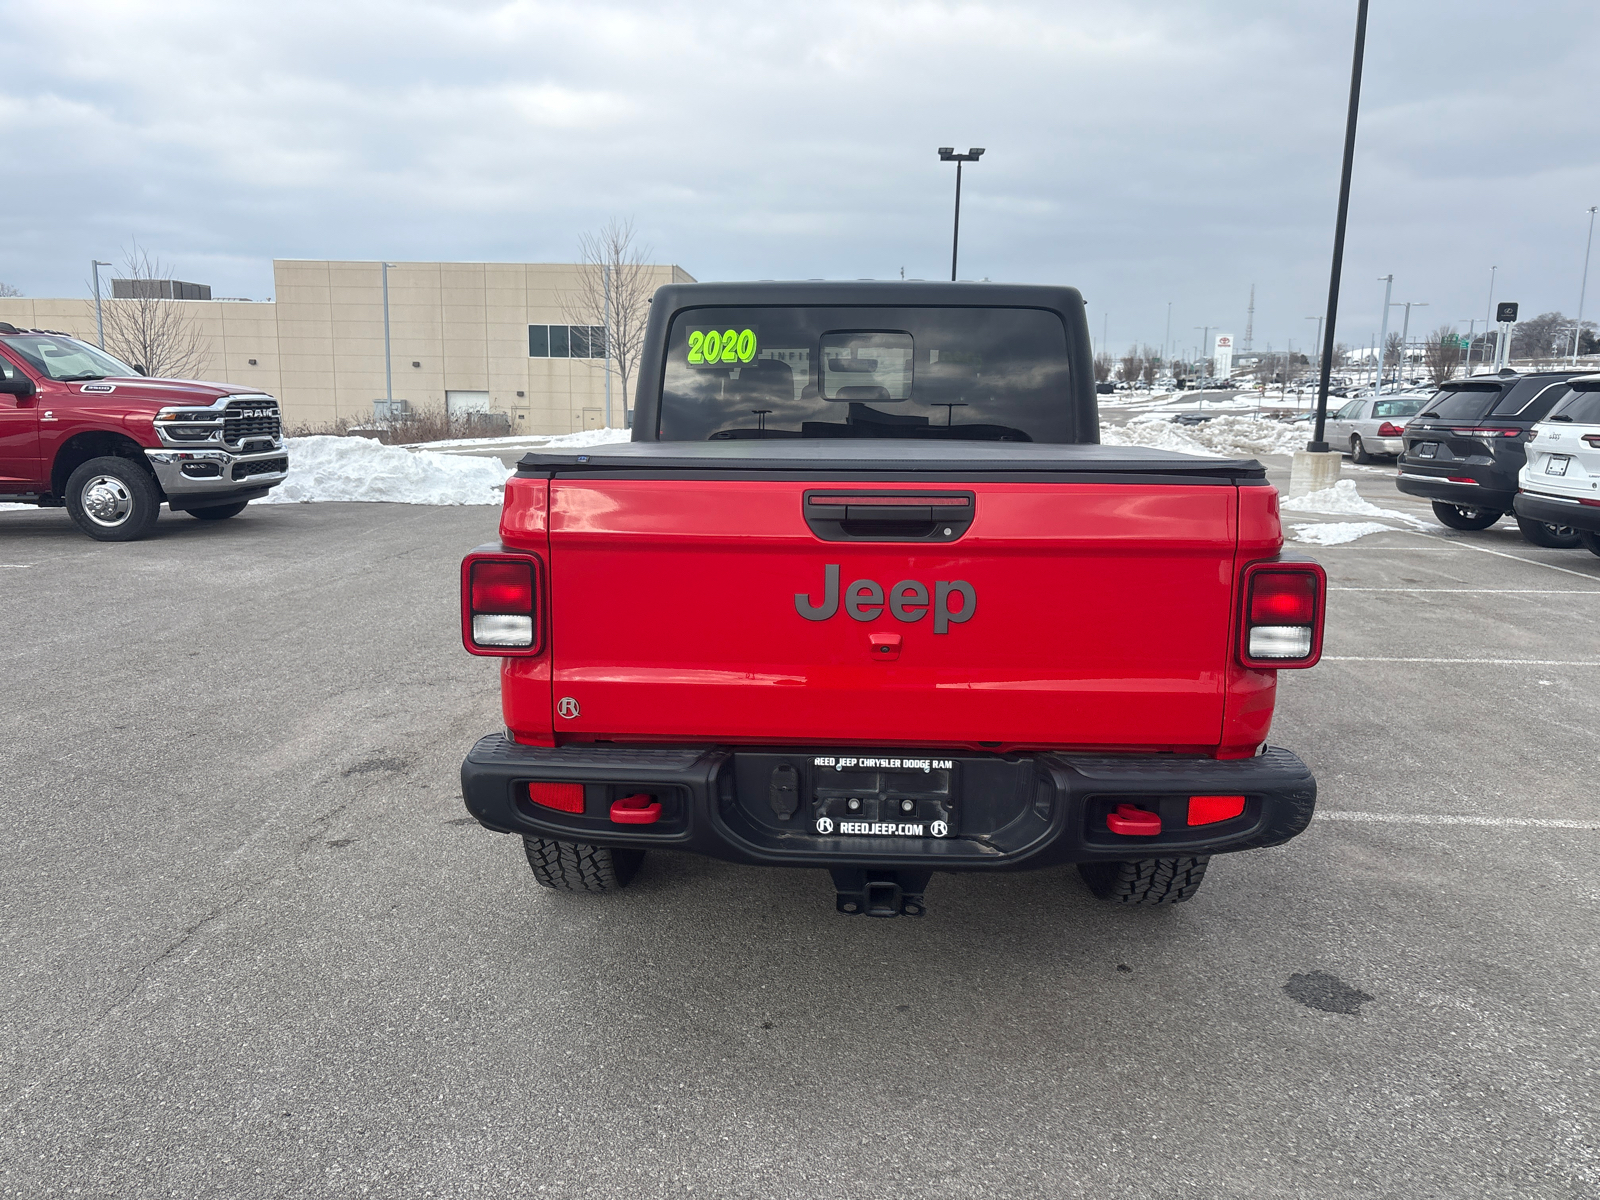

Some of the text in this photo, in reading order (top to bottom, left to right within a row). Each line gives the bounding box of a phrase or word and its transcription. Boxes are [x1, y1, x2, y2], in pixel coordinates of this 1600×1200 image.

[687, 329, 757, 364] 2020
[794, 564, 977, 634] Jeep
[814, 757, 952, 769] REED JEEP CHRYSLER DODGE RAM
[840, 822, 923, 836] REEDJEEP.COM
